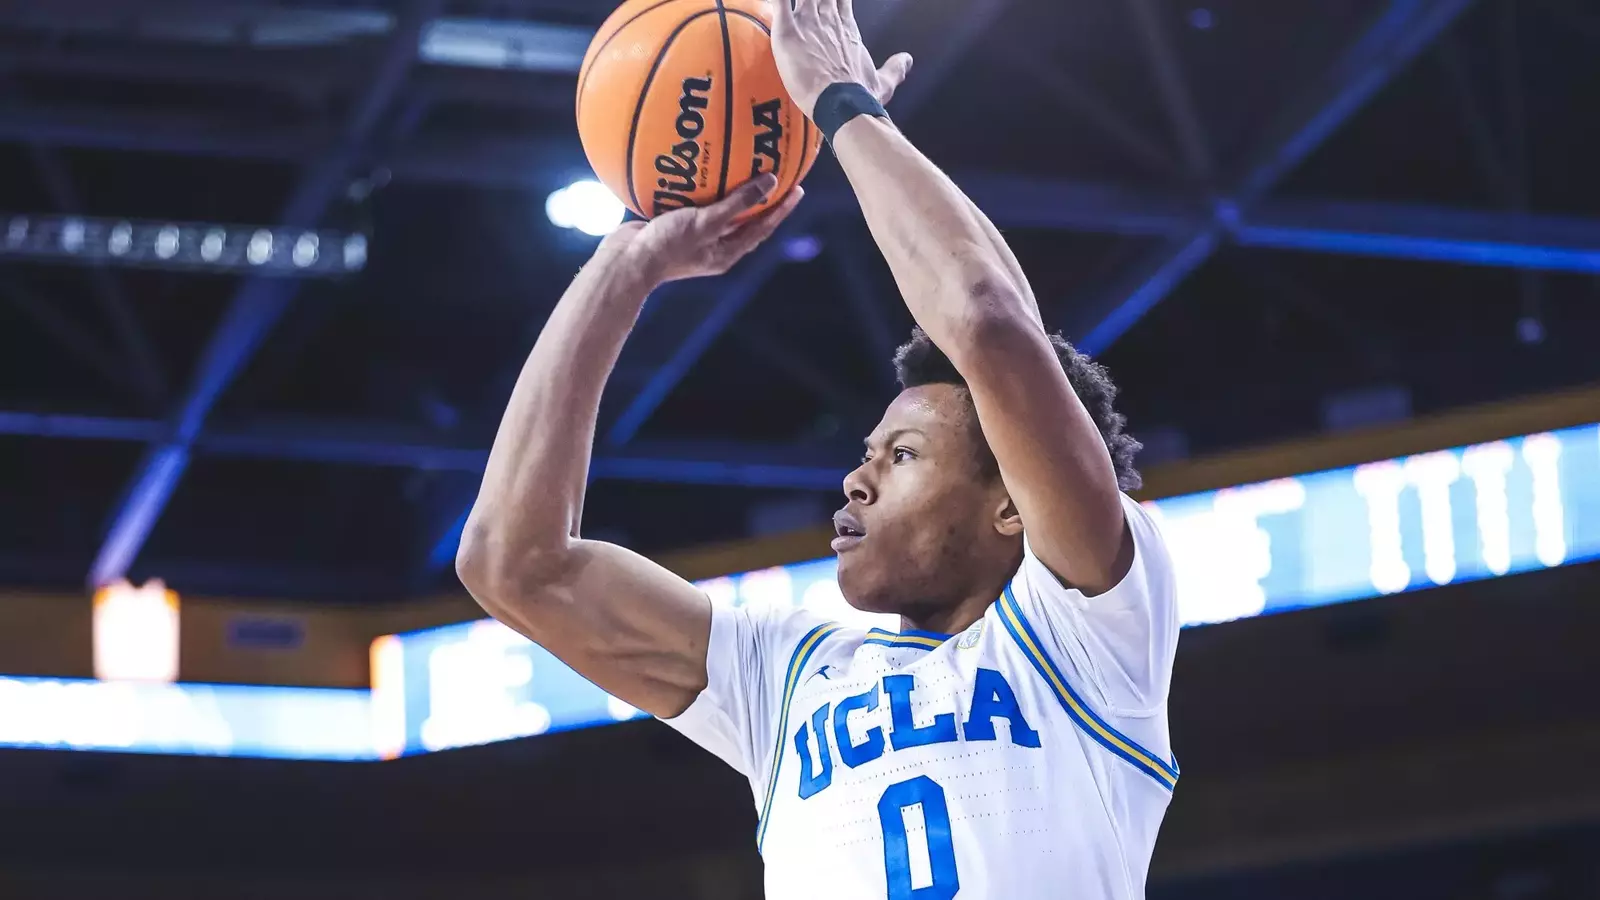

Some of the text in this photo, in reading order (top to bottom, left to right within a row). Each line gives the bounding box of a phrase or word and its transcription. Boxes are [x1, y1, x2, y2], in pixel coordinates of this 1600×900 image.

[751, 98, 783, 204] CAA
[794, 667, 1041, 799] UCLA
[877, 774, 960, 900] 0
